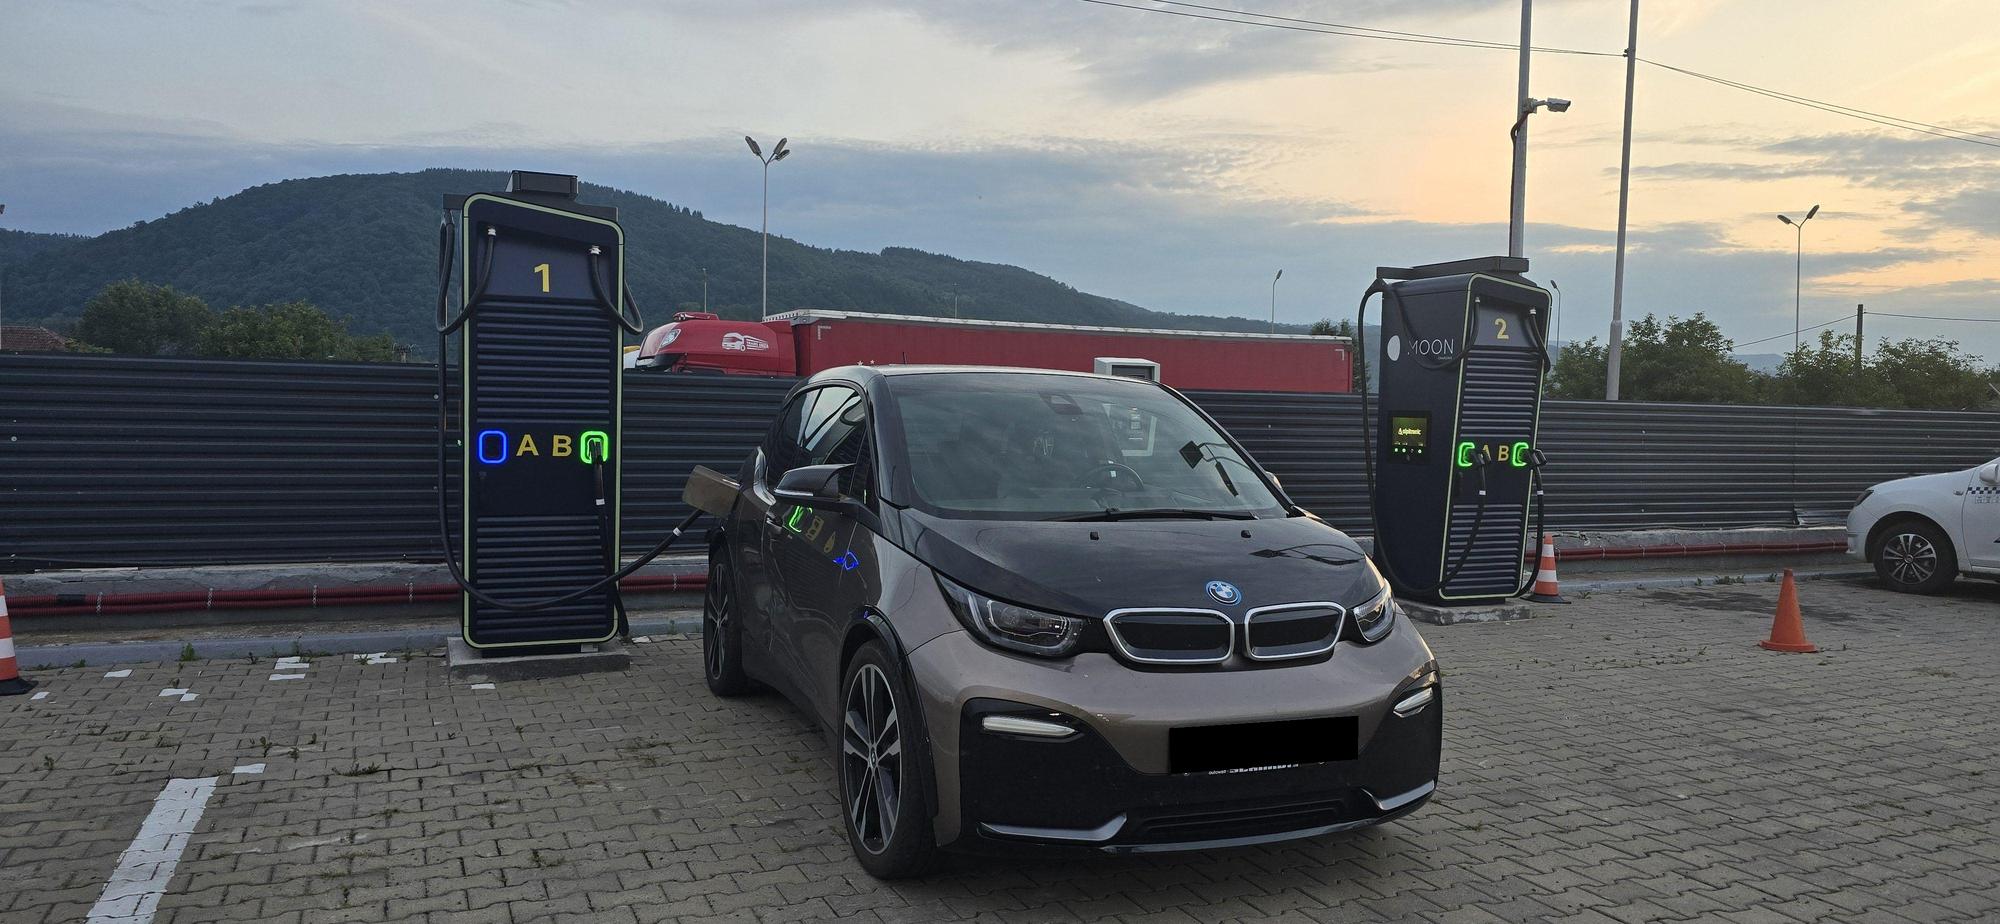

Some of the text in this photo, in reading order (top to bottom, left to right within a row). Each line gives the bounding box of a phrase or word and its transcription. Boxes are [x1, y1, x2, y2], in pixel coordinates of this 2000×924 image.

[533, 263, 550, 293] 1
[1494, 318, 1509, 339] 2
[1408, 338, 1454, 355] MOON
[516, 434, 573, 457] A B
[1498, 445, 1509, 461] B
